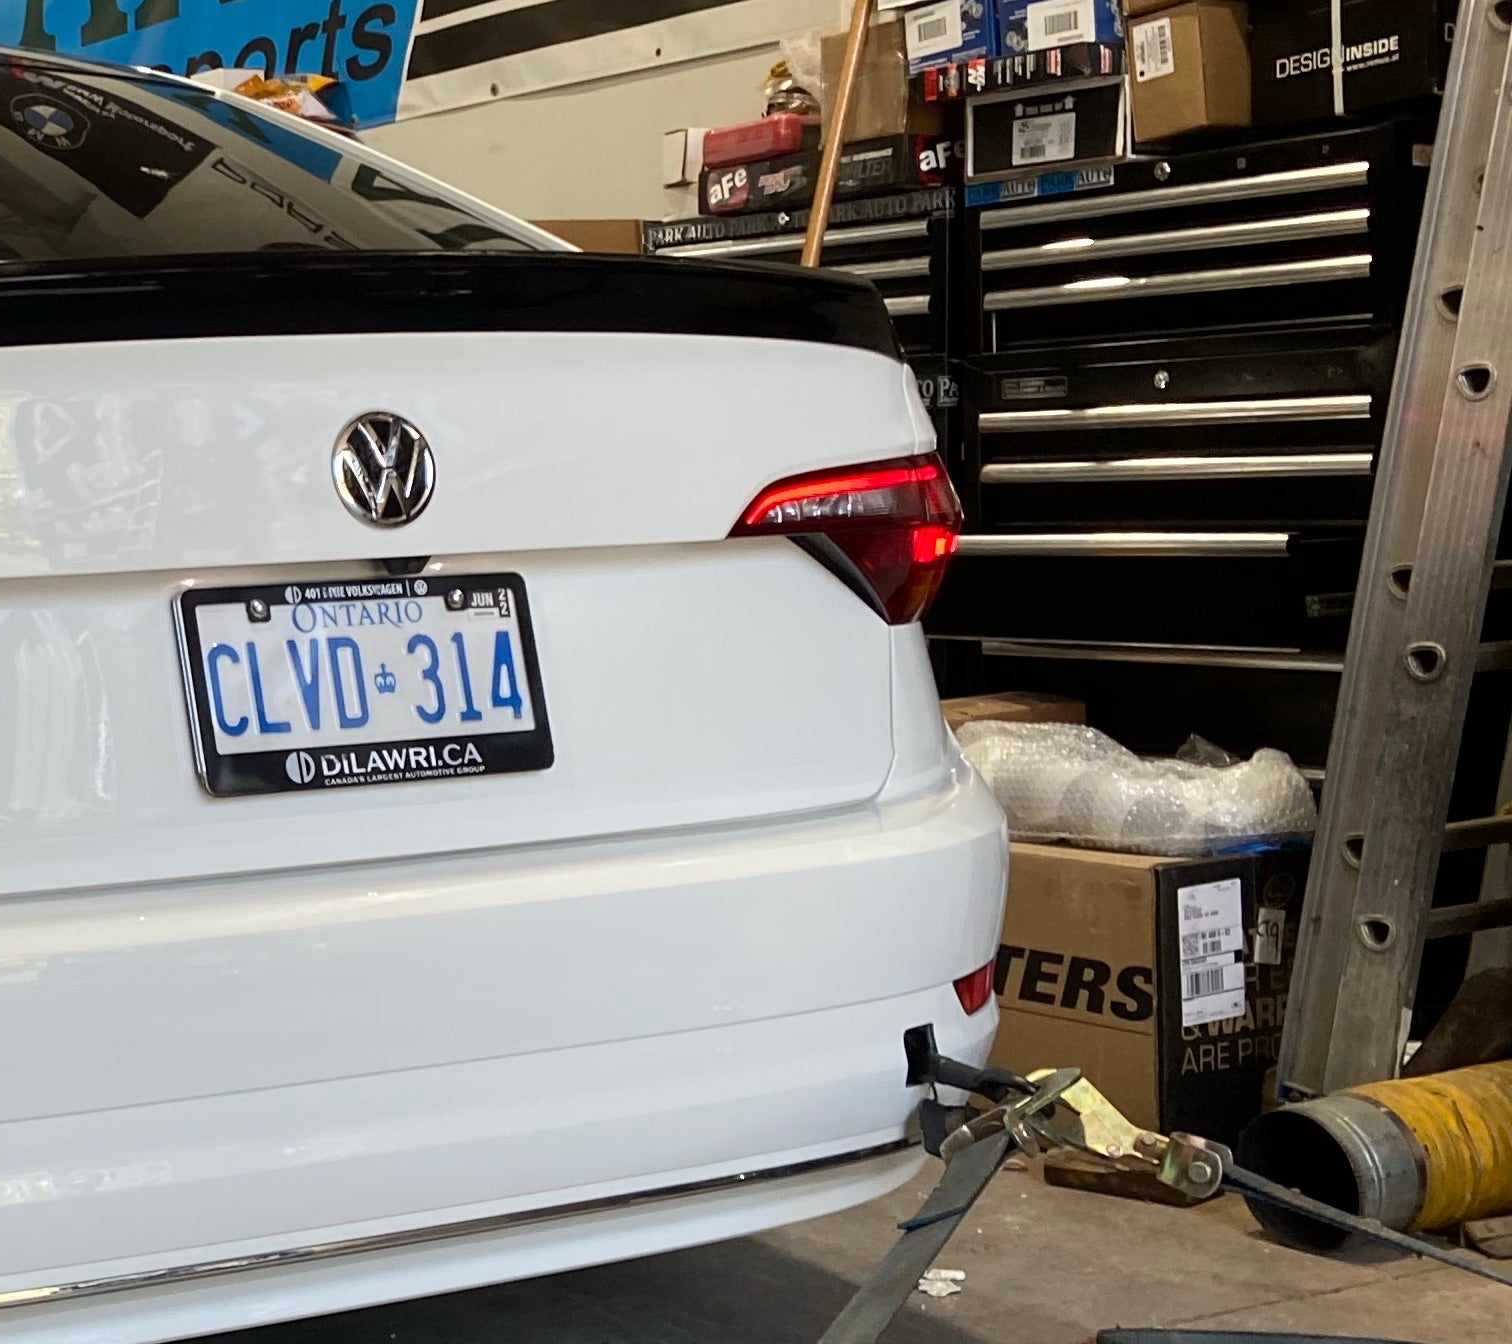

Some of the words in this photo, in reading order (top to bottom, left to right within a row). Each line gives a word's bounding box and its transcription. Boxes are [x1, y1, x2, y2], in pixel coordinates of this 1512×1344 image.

[1276, 45, 1344, 78] DESIG
[1346, 36, 1399, 62] INSIDE
[708, 168, 747, 205] aFe
[1078, 167, 1112, 185] AUTO
[648, 226, 683, 246] PARK
[305, 587, 321, 601] 401
[471, 592, 494, 607] JUN
[207, 637, 369, 736] CLVD
[406, 631, 523, 724] 314
[321, 742, 483, 777] DILAWRI.CA
[324, 775, 365, 786] CANADA'S
[367, 772, 403, 783] LARGEST
[405, 768, 455, 779] AUTOMOTIVE
[1181, 1041, 1230, 1075] ARE
